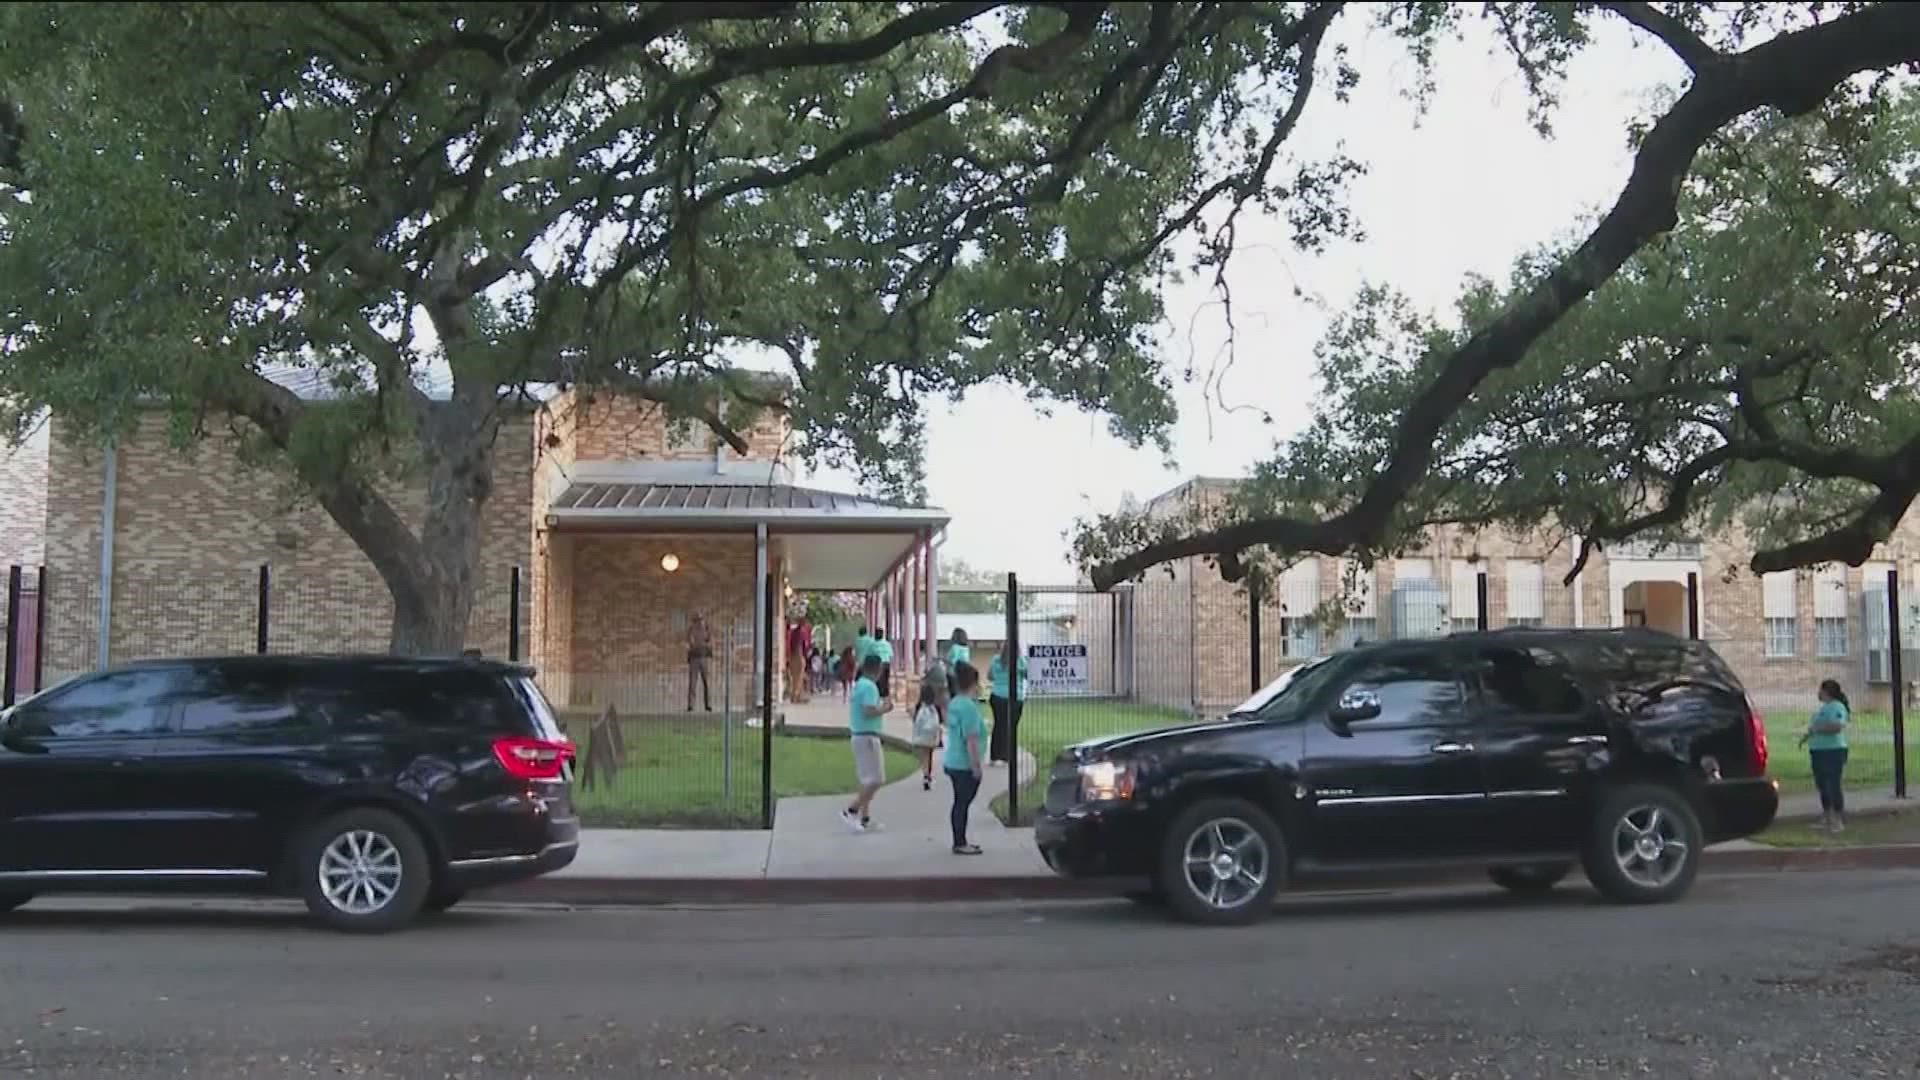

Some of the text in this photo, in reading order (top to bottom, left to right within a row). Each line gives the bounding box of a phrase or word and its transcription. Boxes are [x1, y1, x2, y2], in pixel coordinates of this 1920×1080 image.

[1033, 646, 1082, 657] NOTICE
[1049, 659, 1068, 667] NO
[1041, 669, 1076, 677] MEDIA
